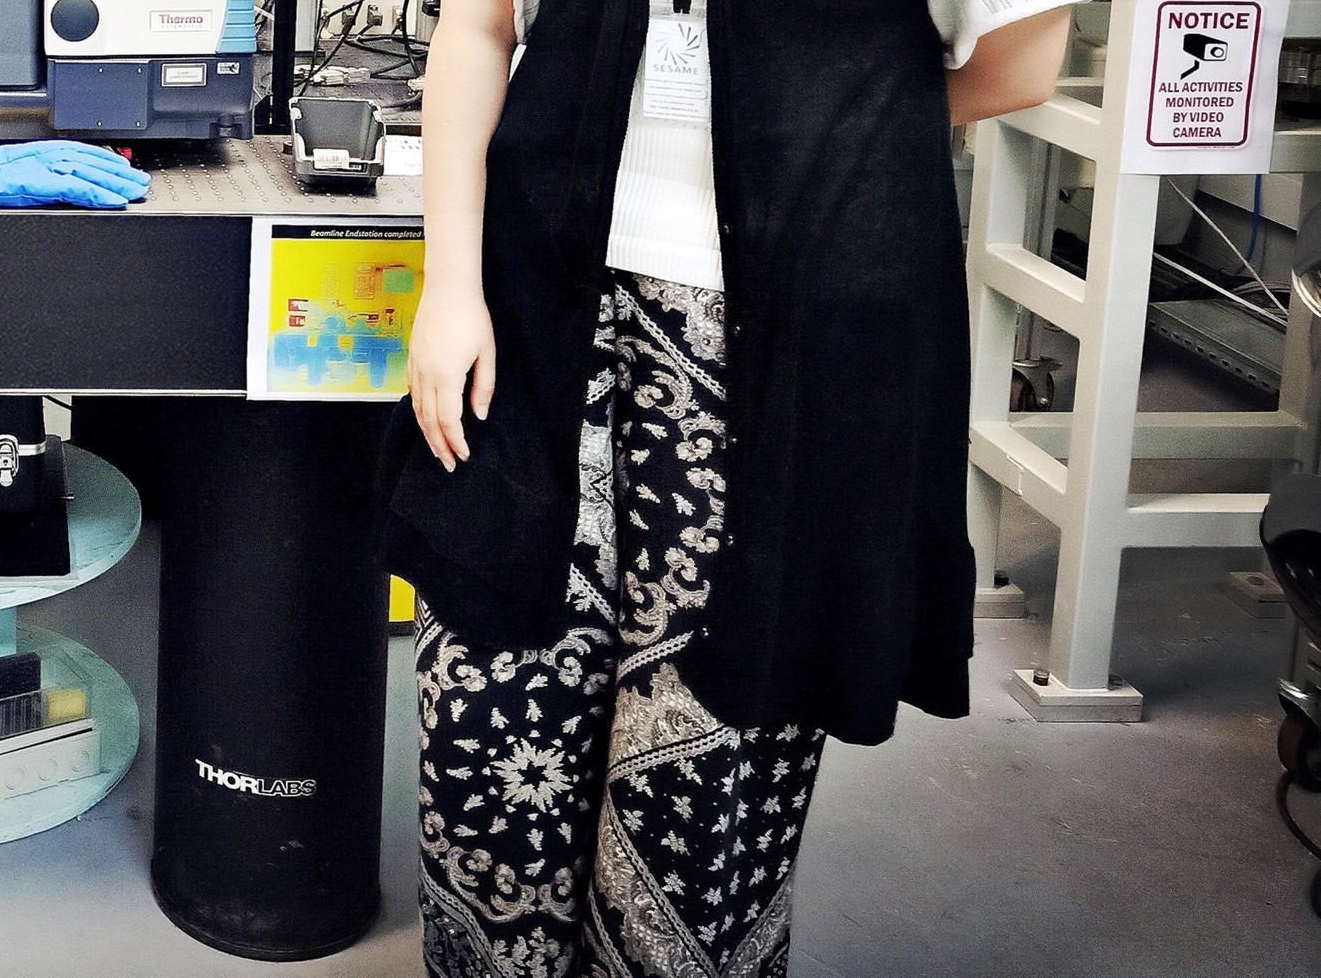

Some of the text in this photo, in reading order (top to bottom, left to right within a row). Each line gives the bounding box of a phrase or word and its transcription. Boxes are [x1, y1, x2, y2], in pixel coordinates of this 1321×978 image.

[159, 14, 204, 24] Thermo
[1168, 12, 1250, 29] NOTICE
[653, 64, 699, 75] SESAME
[1158, 81, 1243, 93] ALL ACTIVITIES
[1165, 97, 1234, 108] MONITORED
[1172, 112, 1224, 123] BY VIDEO
[1172, 127, 1222, 138] CAMERA
[310, 229, 422, 239] Beamline Endstation completed
[195, 758, 317, 797] THORLABS
